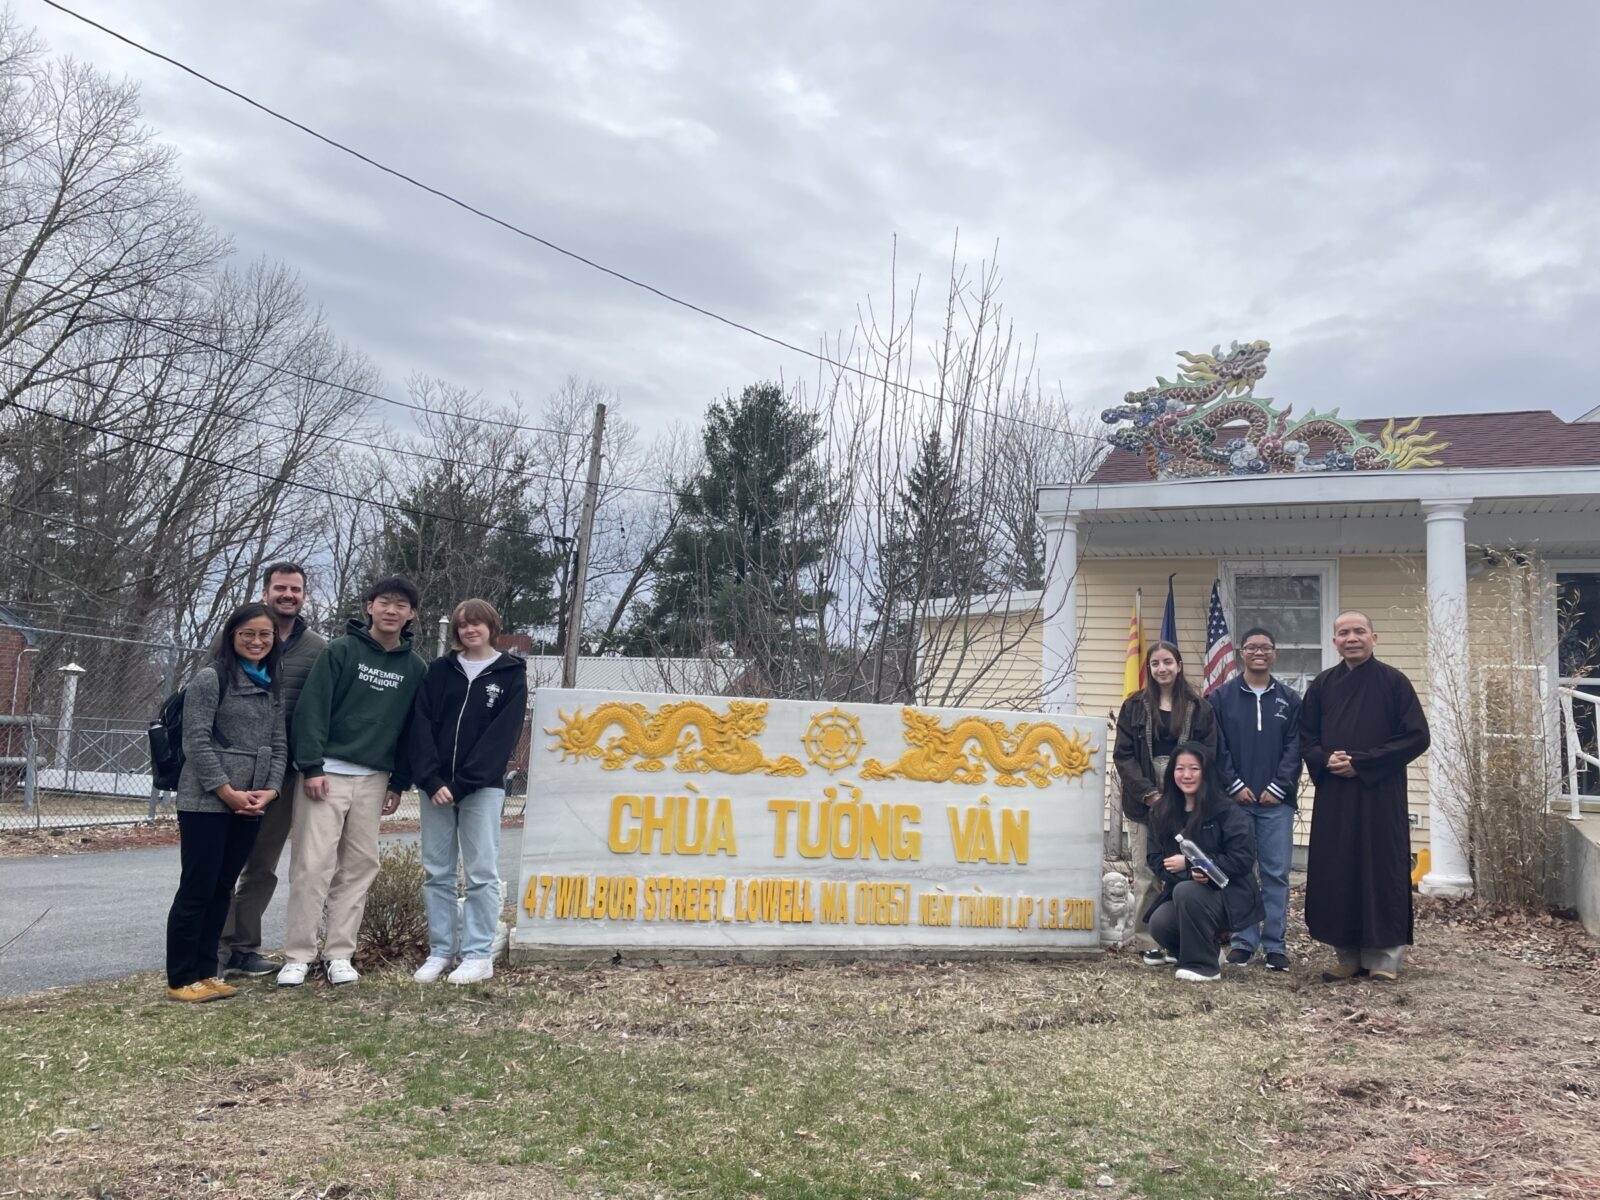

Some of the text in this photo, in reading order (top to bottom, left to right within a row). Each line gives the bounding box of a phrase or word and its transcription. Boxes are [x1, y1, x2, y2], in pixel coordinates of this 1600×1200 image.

[608, 781, 738, 856] CHÙA
[946, 794, 1030, 865] VÂN
[523, 874, 553, 919] 47
[555, 875, 638, 921] WILBUR
[735, 878, 815, 923] LOWELL
[820, 880, 849, 925] MA
[855, 882, 911, 926] 01851
